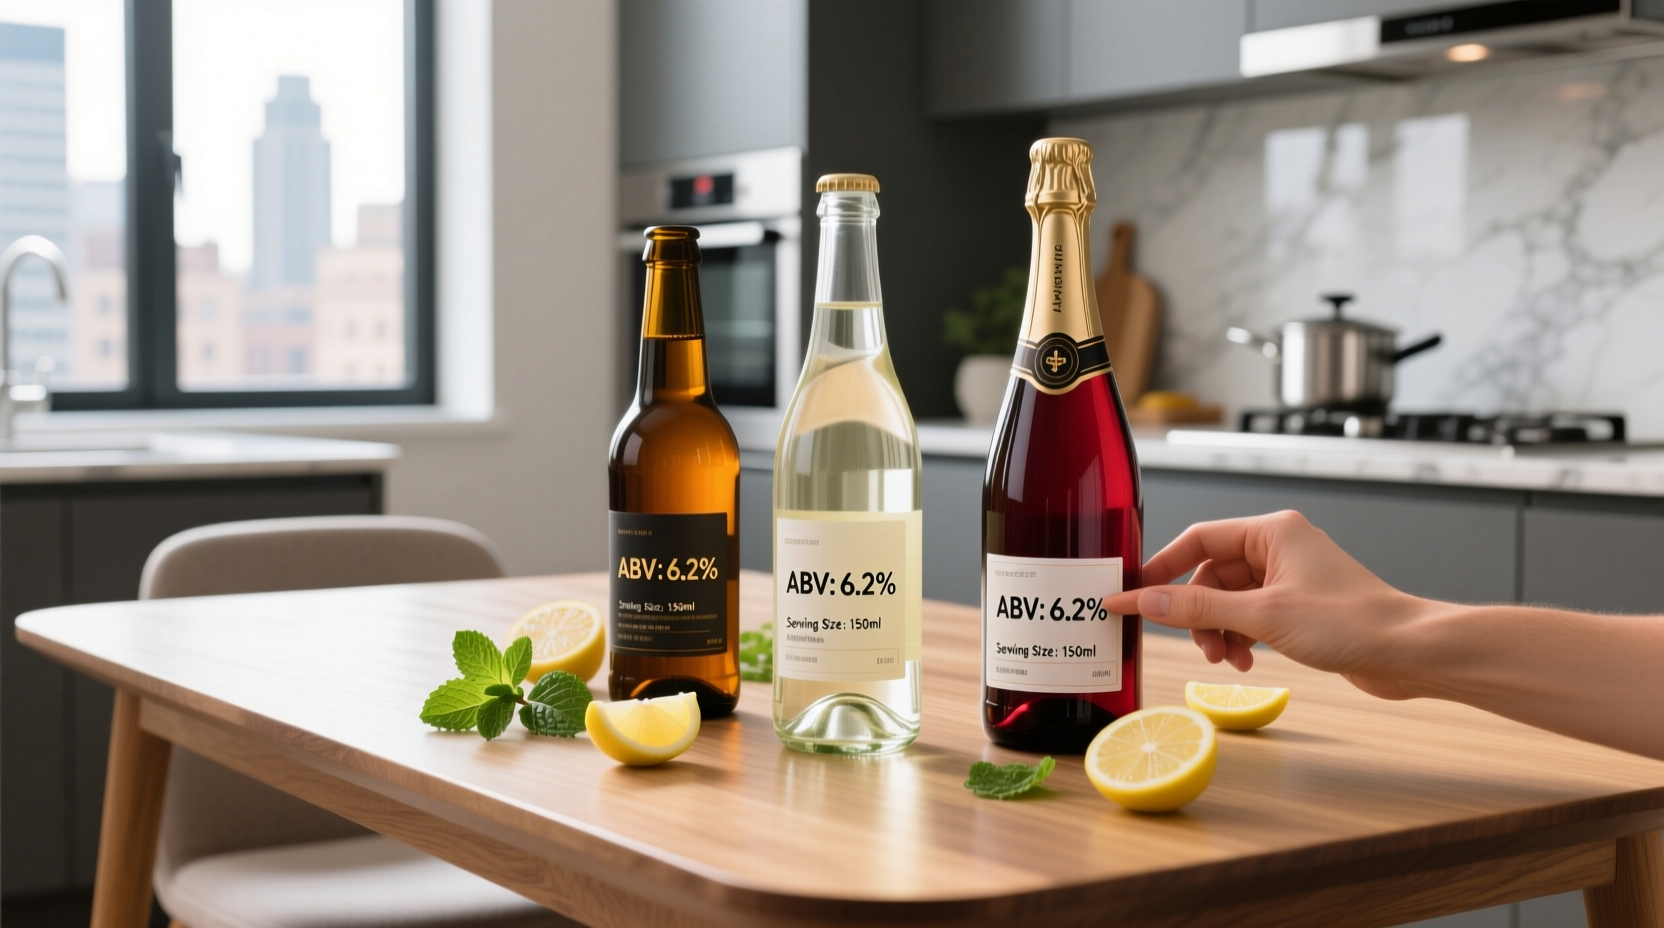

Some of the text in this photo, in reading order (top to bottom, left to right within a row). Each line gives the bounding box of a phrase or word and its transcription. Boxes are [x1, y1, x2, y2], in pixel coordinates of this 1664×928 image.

[618, 556, 718, 581] ABV: 6.2%
[786, 570, 896, 596] ABV: 6.2%
[996, 594, 1108, 622] ABV: 6.2%
[821, 618, 846, 630] Sze:
[850, 616, 881, 630] 150ml
[1062, 644, 1096, 658] 150ml
